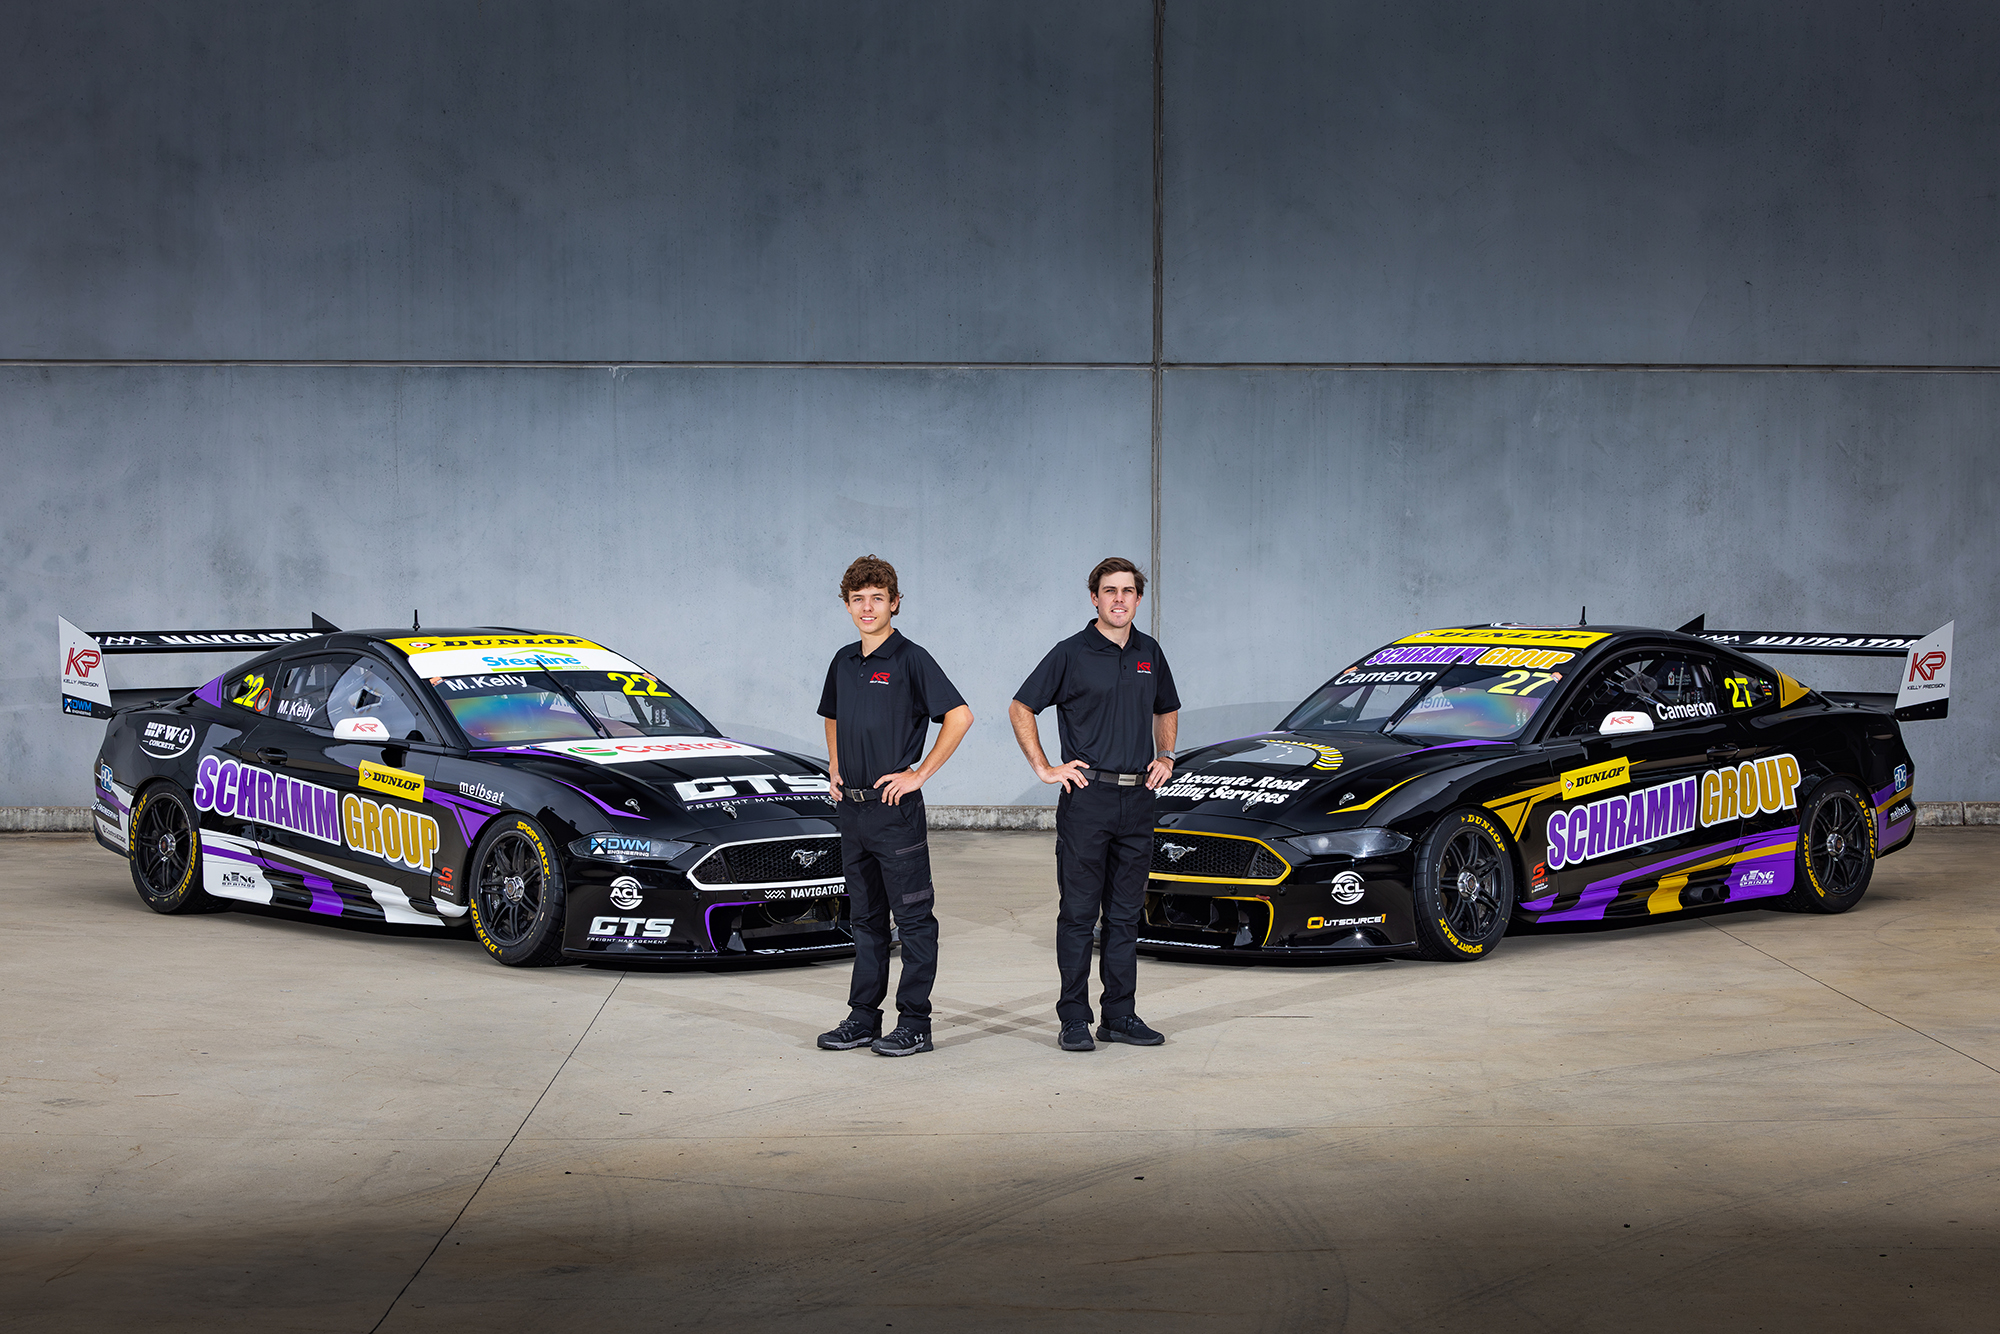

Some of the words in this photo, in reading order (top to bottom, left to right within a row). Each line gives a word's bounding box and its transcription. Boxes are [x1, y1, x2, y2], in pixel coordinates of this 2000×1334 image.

[159, 632, 324, 645] NAVIGATO
[442, 638, 583, 647] DUNLOP
[1434, 632, 1593, 640] DUNLOP
[482, 655, 581, 668] Steeline
[1136, 661, 1151, 672] KR
[1364, 646, 1490, 666] SCHRAMM
[1475, 647, 1576, 670] GROUP
[443, 674, 528, 692] M.Kelly
[607, 672, 672, 698] 22
[870, 671, 890, 682] KR
[1334, 669, 1437, 686] Cameron
[1487, 669, 1555, 697] 27
[233, 674, 265, 708] 22
[1724, 678, 1753, 708] 27
[72, 699, 92, 712] DWM
[277, 700, 315, 721] M.Kelly
[1656, 701, 1717, 721] Cameron
[148, 739, 175, 750] CONCRETE
[615, 741, 741, 753] Castrol
[372, 771, 421, 792] DUNLOP
[1172, 772, 1253, 786] Accurate
[1252, 777, 1310, 791] Road
[1575, 766, 1626, 788] DUNLOP
[459, 782, 504, 804] melbsat
[673, 774, 831, 802] GTS
[1209, 786, 1290, 804] Services
[686, 800, 749, 811] FREIGHT
[755, 794, 834, 803] MANAGEME
[1547, 775, 1697, 870] SCHRAMM
[1700, 753, 1801, 828] GROUP
[130, 793, 148, 852] DUNLOP
[193, 755, 341, 846] SCHRAMM
[342, 793, 440, 873] GROUP
[1467, 814, 1506, 852] DUNLOP
[1858, 799, 1875, 860] DUNLOP
[516, 820, 540, 842] SPORT
[536, 841, 550, 876] MAXX
[607, 838, 651, 852] DWM
[1803, 832, 1812, 867] MAXX
[222, 871, 255, 884] KING
[1807, 868, 1826, 898] SPORT
[610, 887, 643, 899] ACL
[790, 884, 845, 898] NAVIGATOR
[1331, 883, 1365, 894] ACL
[470, 898, 498, 953] DUNLOP
[589, 916, 675, 938] GTS
[1438, 917, 1459, 946] MAXX
[1457, 941, 1483, 954] SPORT
